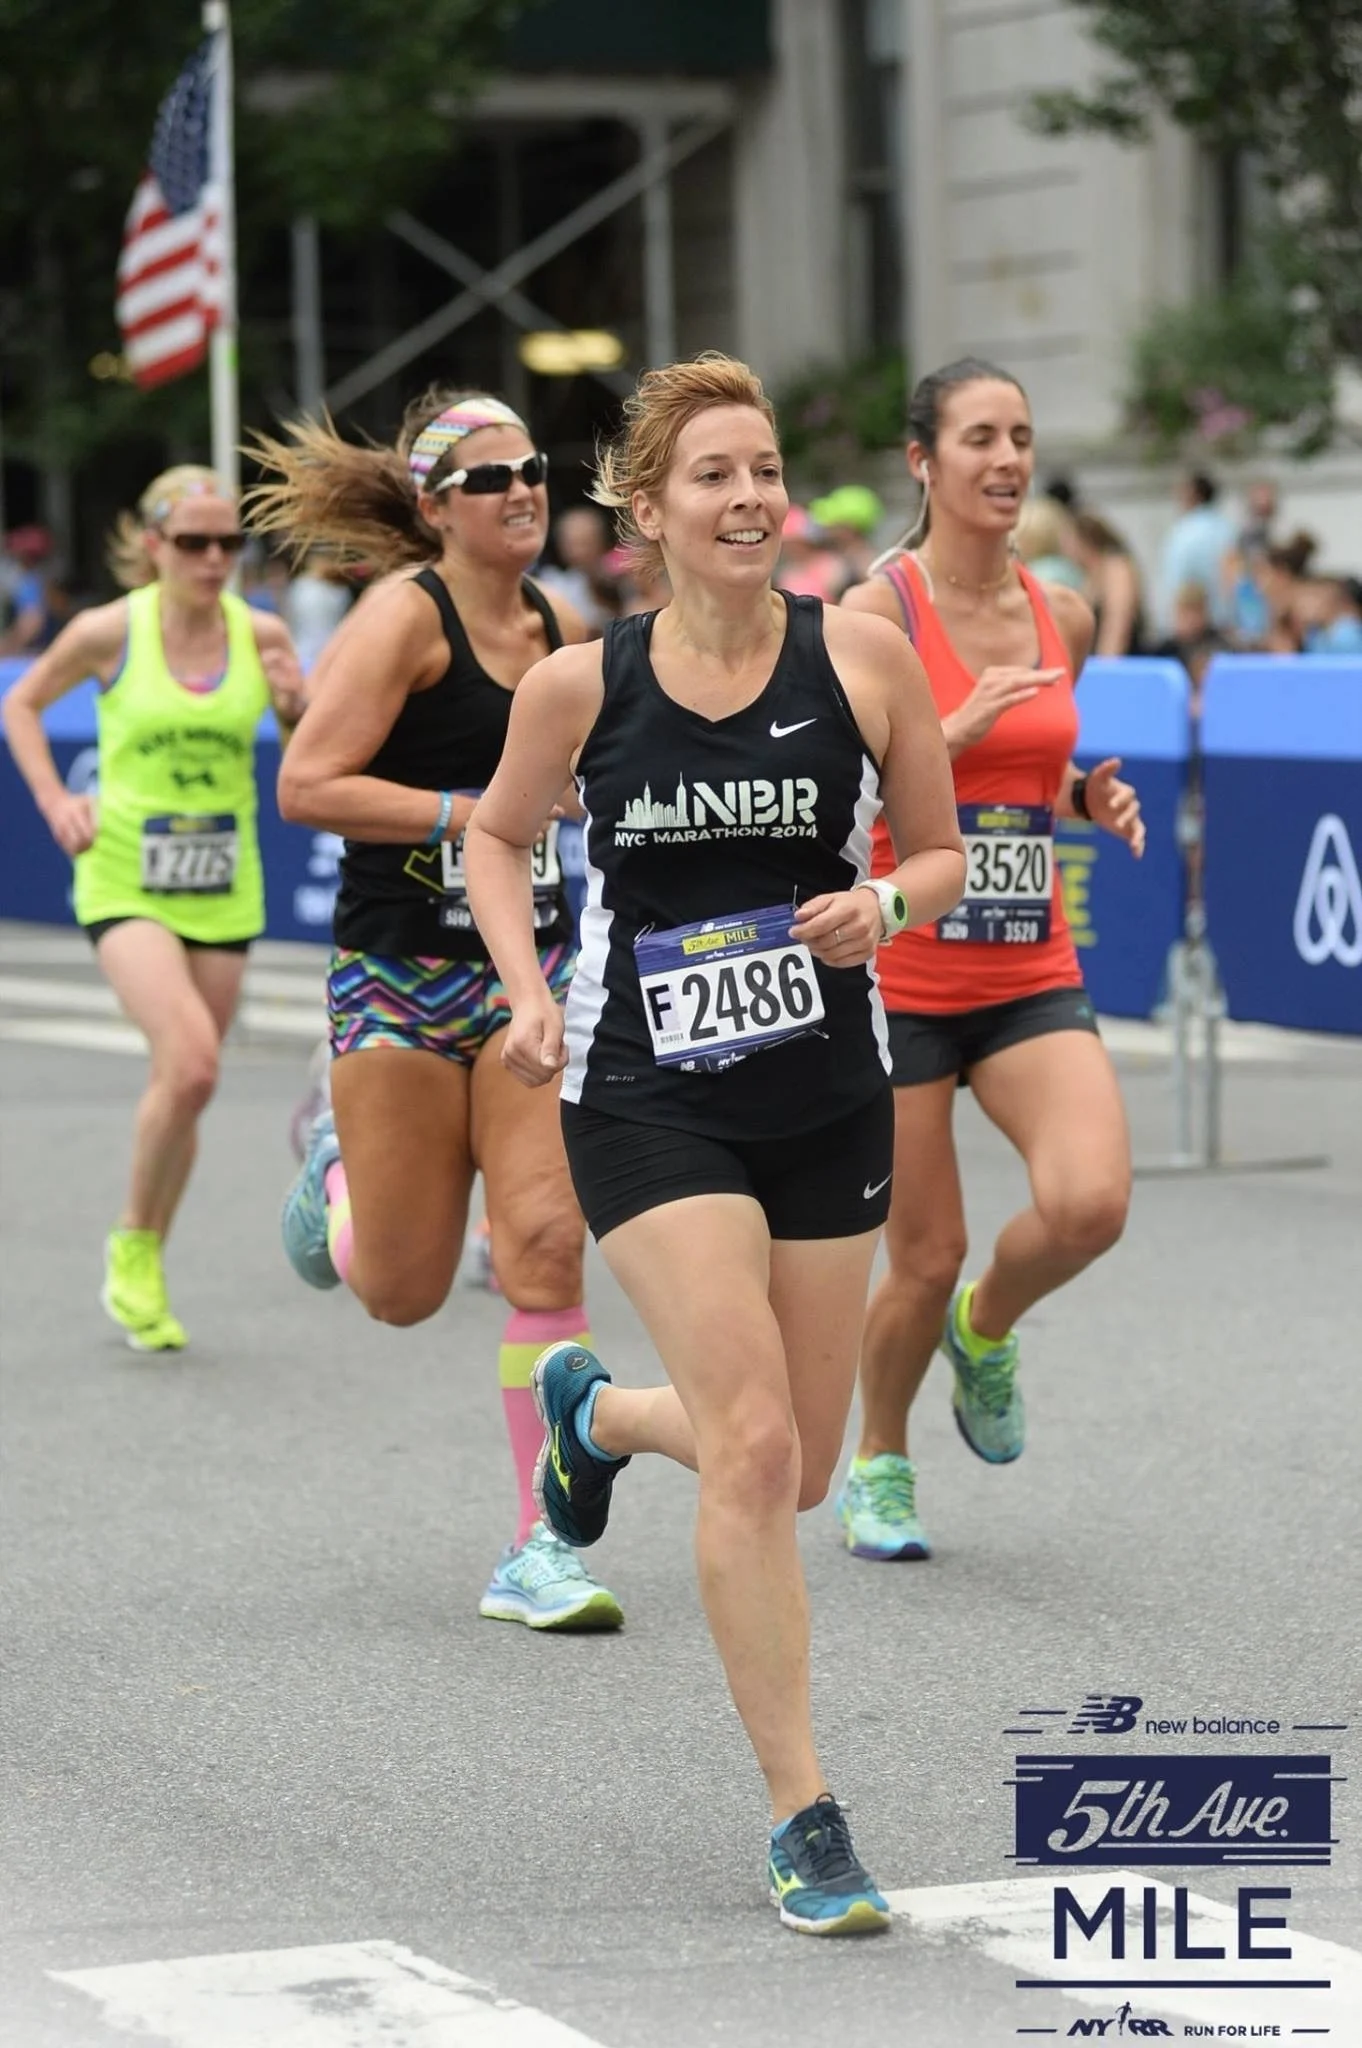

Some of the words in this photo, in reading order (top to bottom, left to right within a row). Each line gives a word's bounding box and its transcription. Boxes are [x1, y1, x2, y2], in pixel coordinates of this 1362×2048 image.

[693, 777, 819, 827] NBR
[614, 831, 646, 848] NYC
[653, 826, 765, 844] MARATHON
[770, 823, 818, 840] 2014
[969, 842, 1047, 893] 3520
[725, 927, 758, 944] MILE
[646, 983, 672, 1032] F
[681, 953, 814, 1042] 2486
